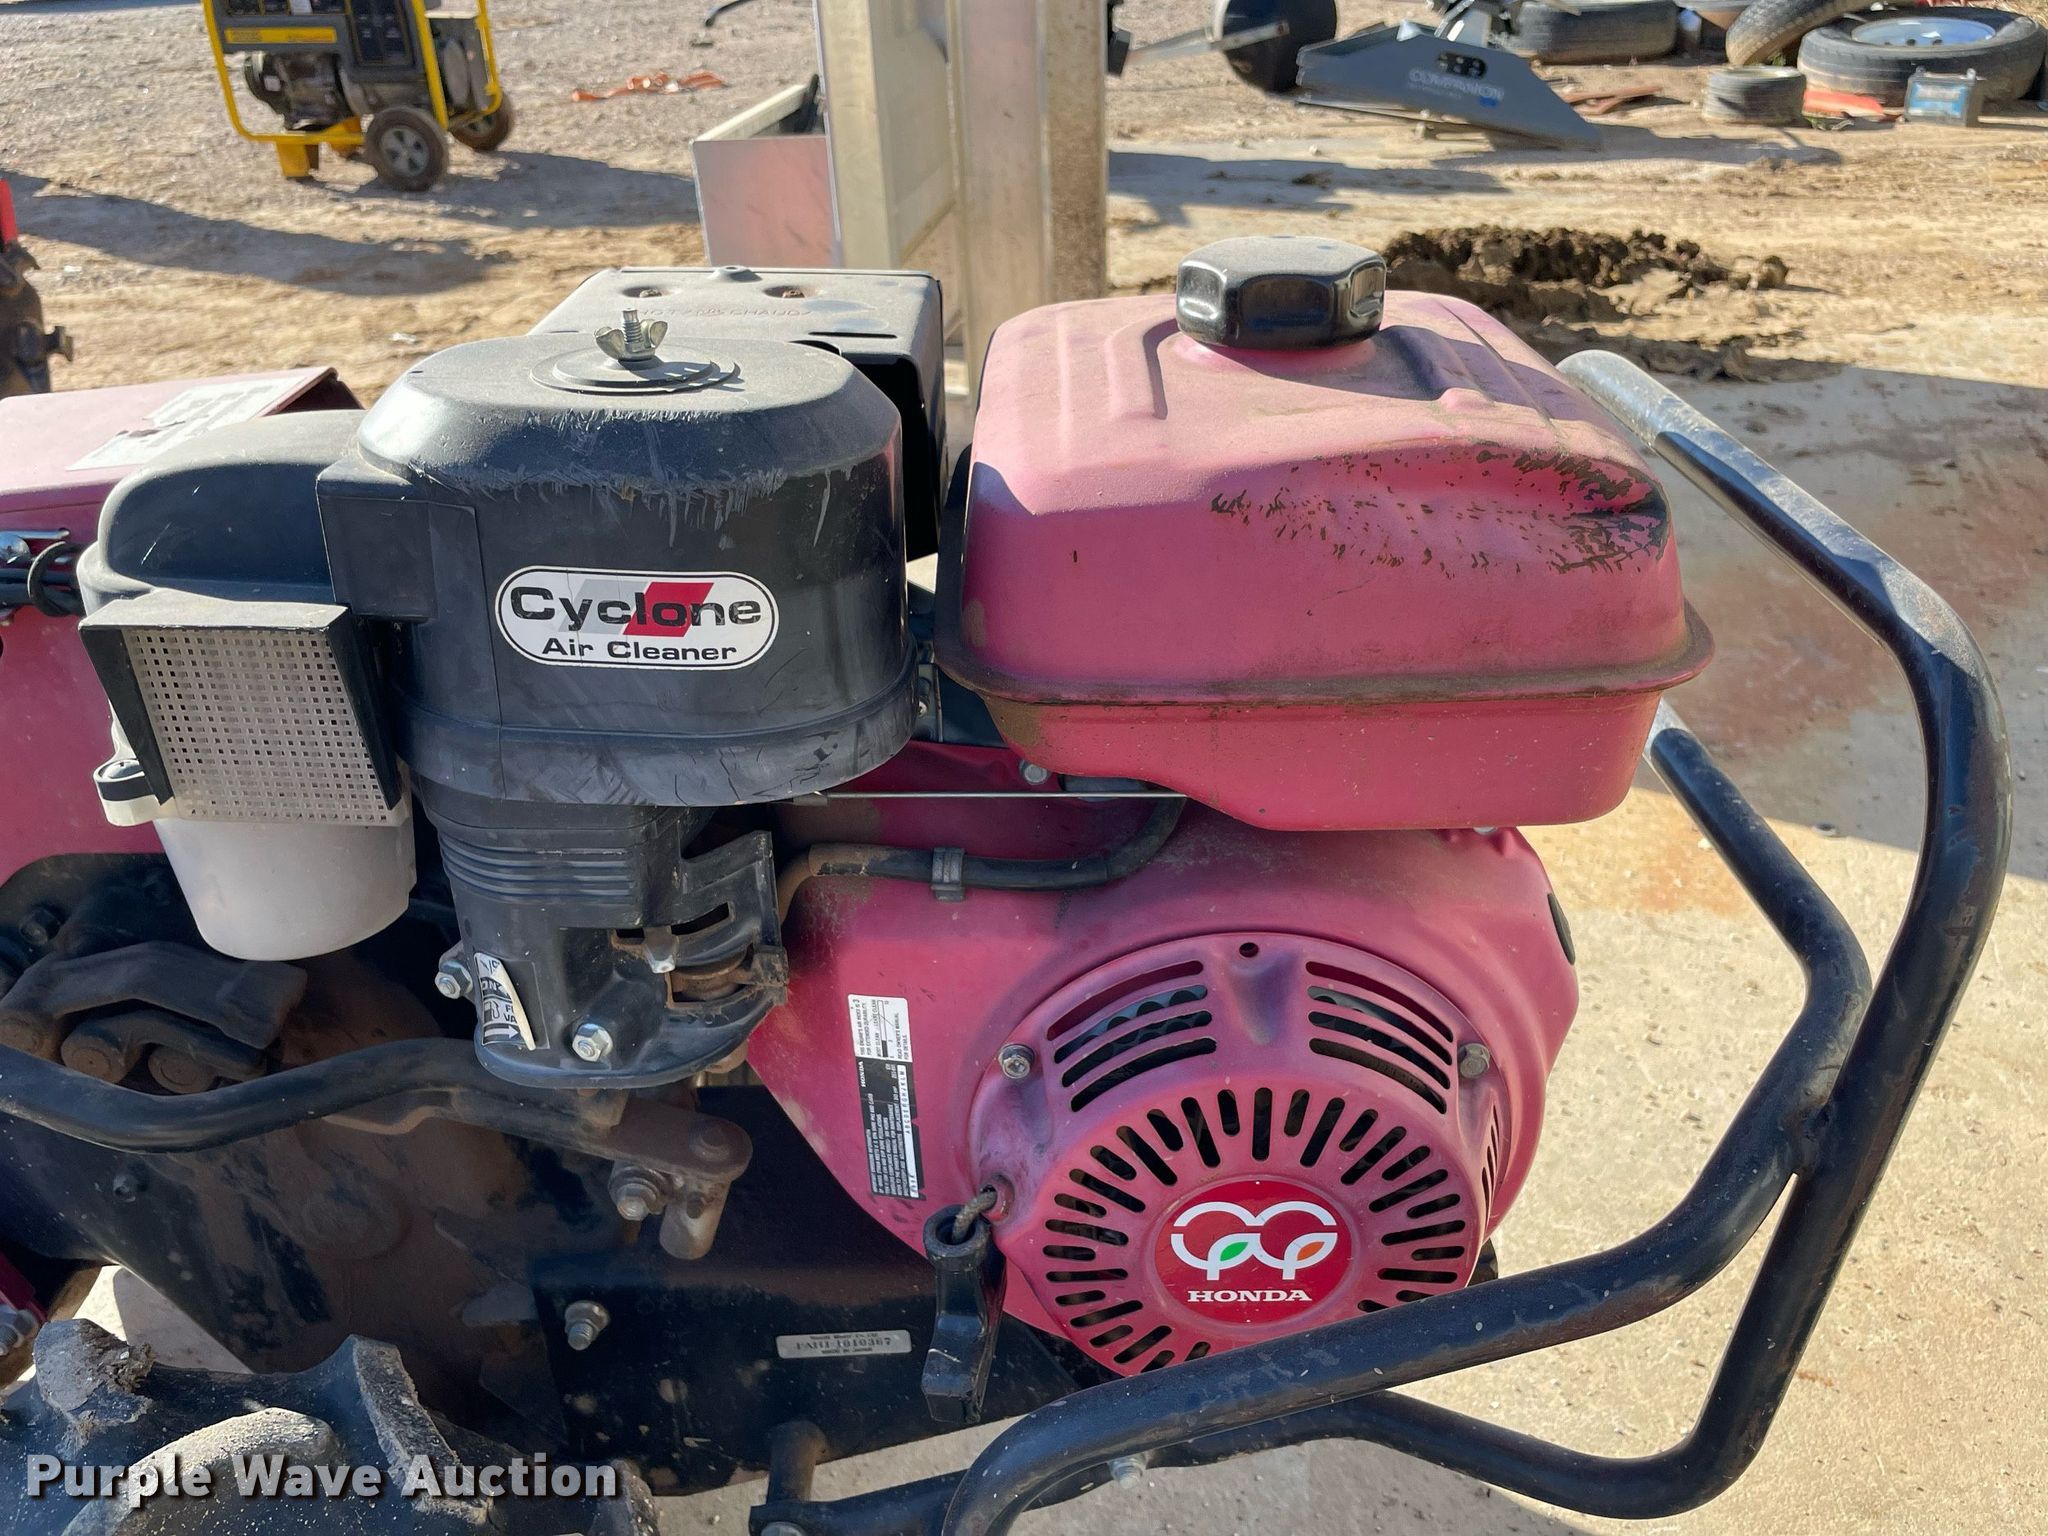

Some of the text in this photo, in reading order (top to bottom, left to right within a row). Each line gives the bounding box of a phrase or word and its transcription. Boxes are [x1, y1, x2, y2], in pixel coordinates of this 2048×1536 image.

[510, 586, 761, 631] Cyclone
[542, 637, 737, 660] Air Cleaner
[1187, 1289, 1313, 1302] HONDA
